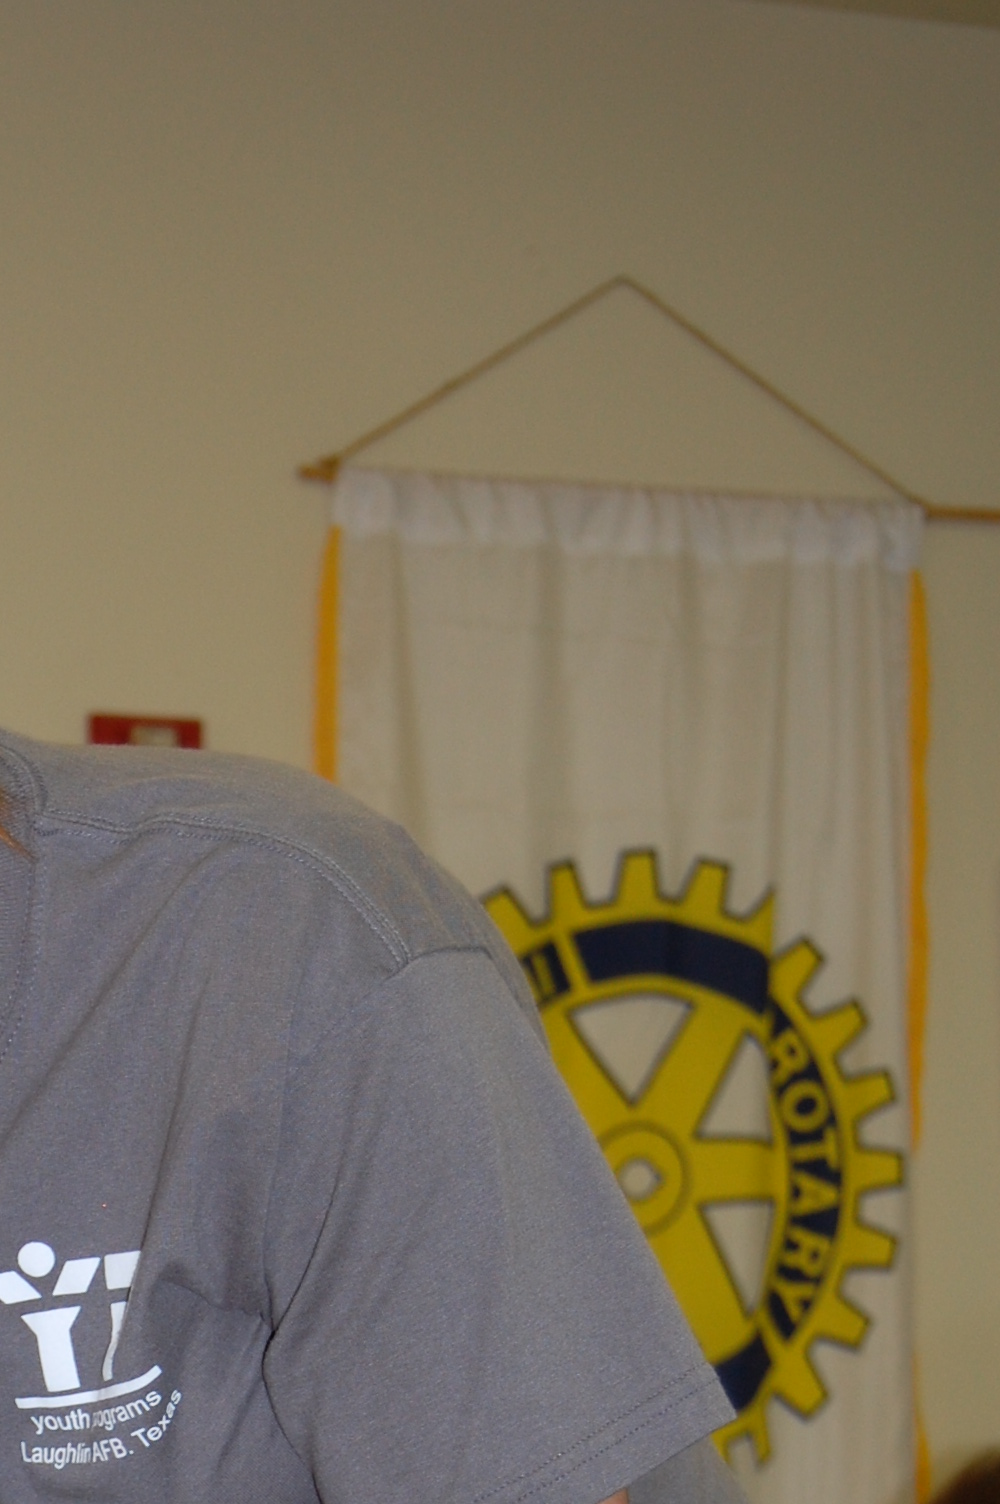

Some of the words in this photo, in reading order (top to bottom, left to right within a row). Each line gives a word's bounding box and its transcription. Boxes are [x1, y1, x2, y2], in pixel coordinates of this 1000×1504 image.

[770, 1027, 840, 1324] ROTARY
[30, 1409, 90, 1435] youth
[130, 1389, 182, 1448] Texas
